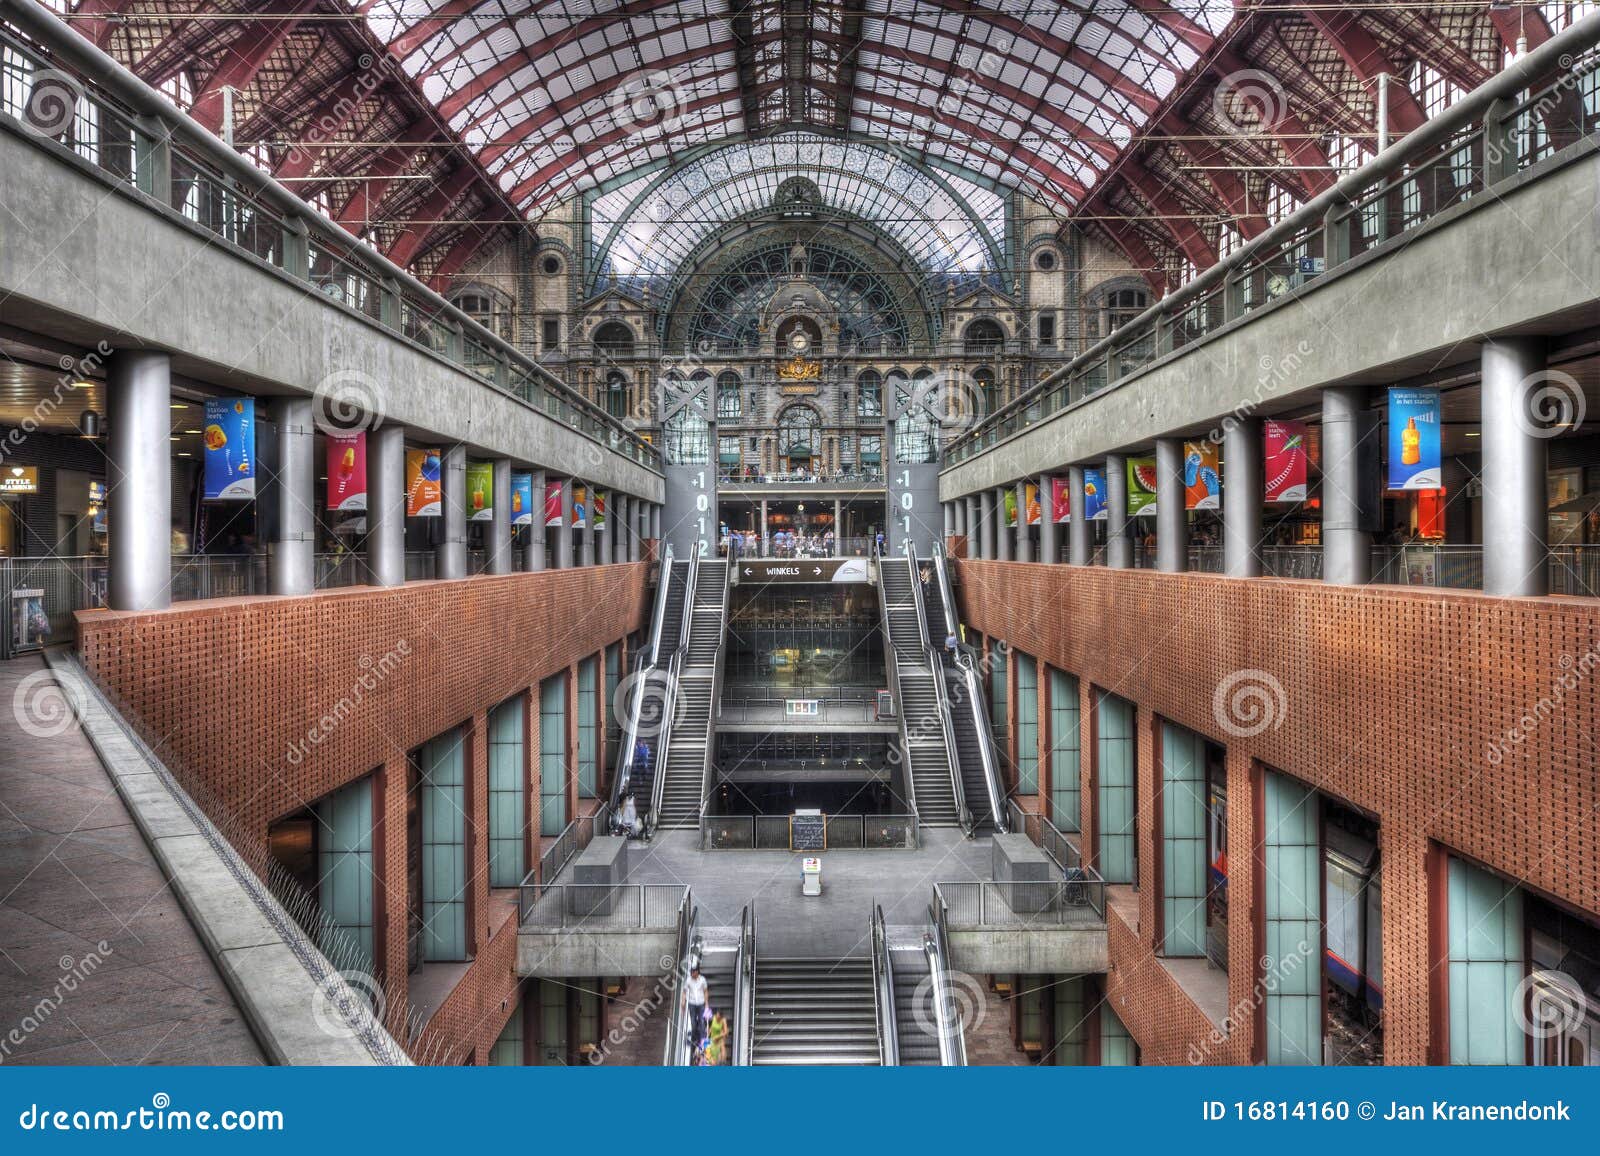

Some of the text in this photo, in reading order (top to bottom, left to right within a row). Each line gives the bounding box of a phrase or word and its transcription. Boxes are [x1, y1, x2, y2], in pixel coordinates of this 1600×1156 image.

[691, 472, 705, 489] +1
[896, 470, 910, 488] +1
[696, 494, 708, 512] 0
[901, 492, 913, 511] 0
[766, 567, 800, 576] WINKELS
